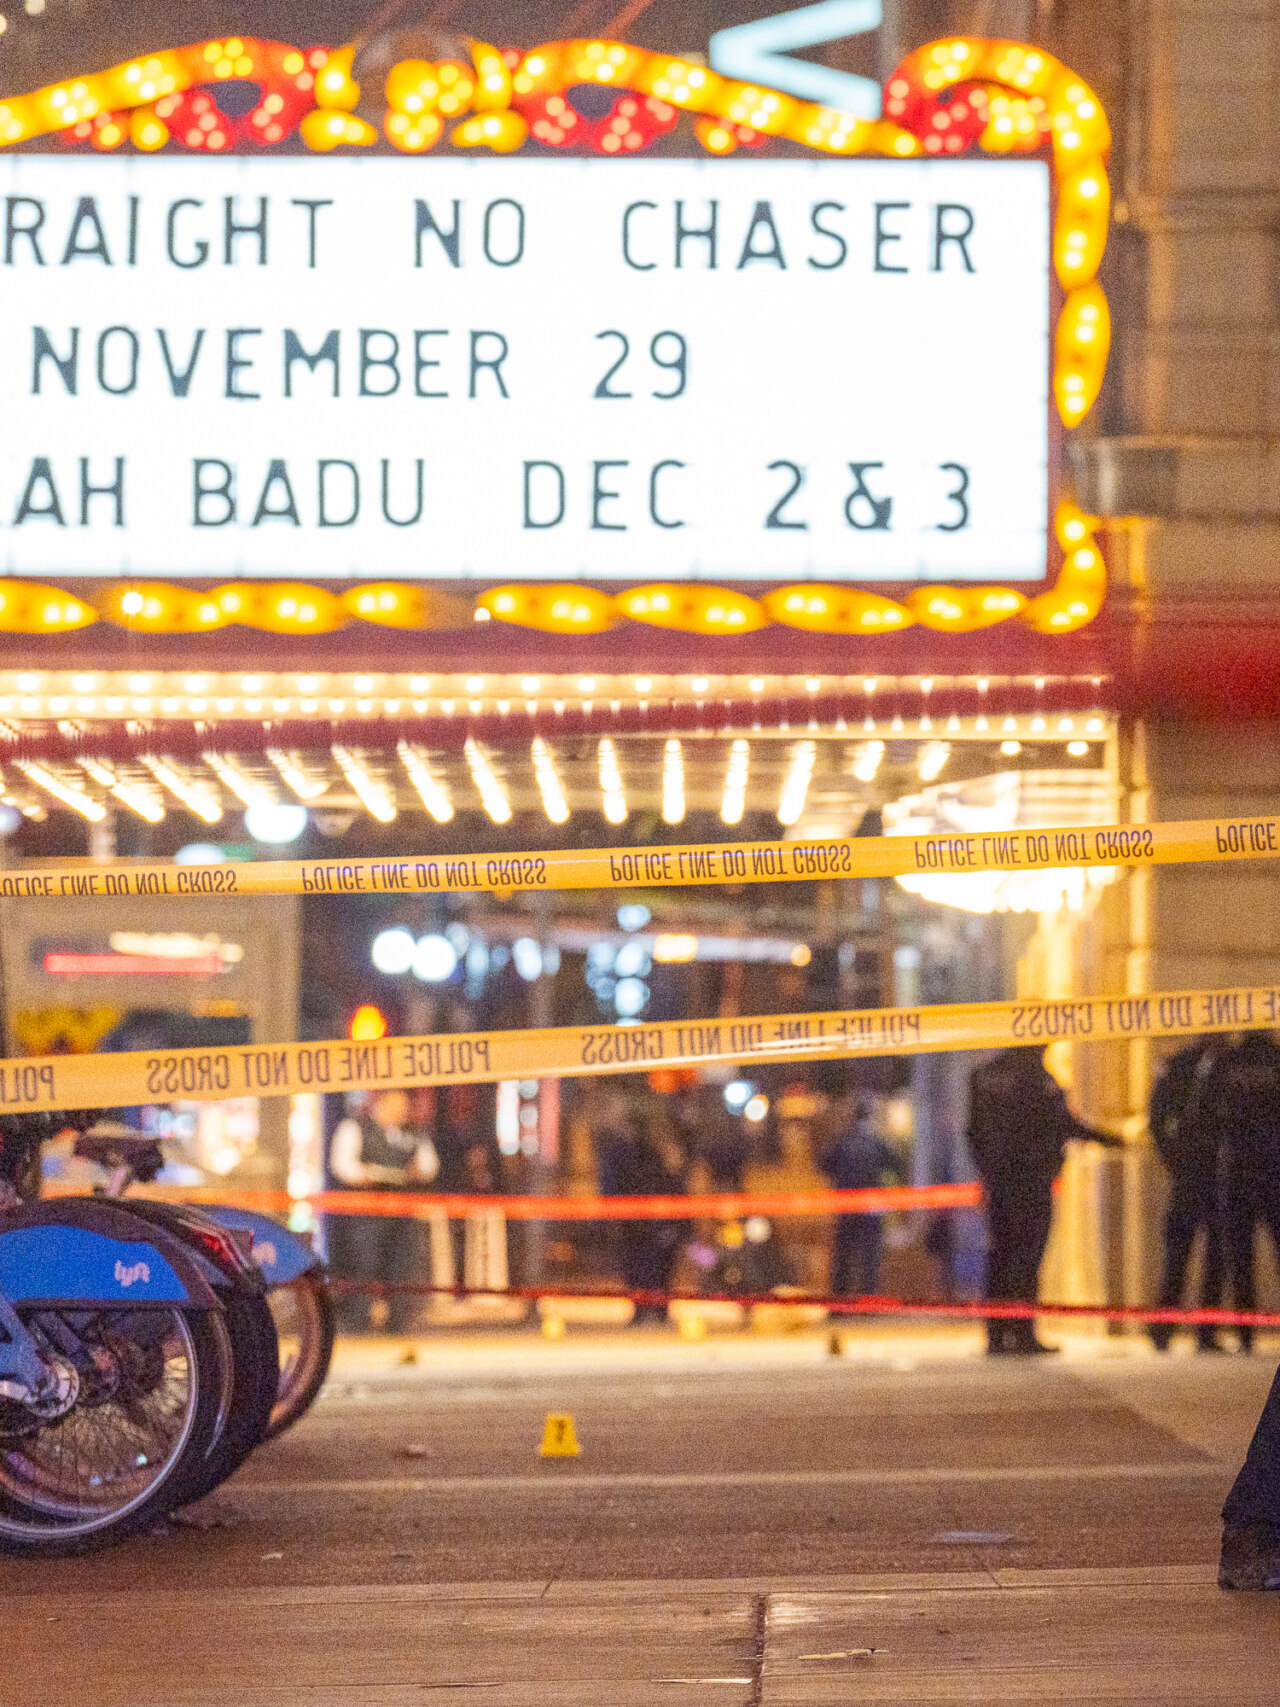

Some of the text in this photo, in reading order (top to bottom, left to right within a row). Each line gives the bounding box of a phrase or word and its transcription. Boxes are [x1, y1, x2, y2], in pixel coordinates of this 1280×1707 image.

[3, 196, 976, 273] RAIGHT NO CHASER
[31, 326, 687, 399] NOVEMBER 29
[13, 457, 970, 532] AH BADU DEC 2 & 3
